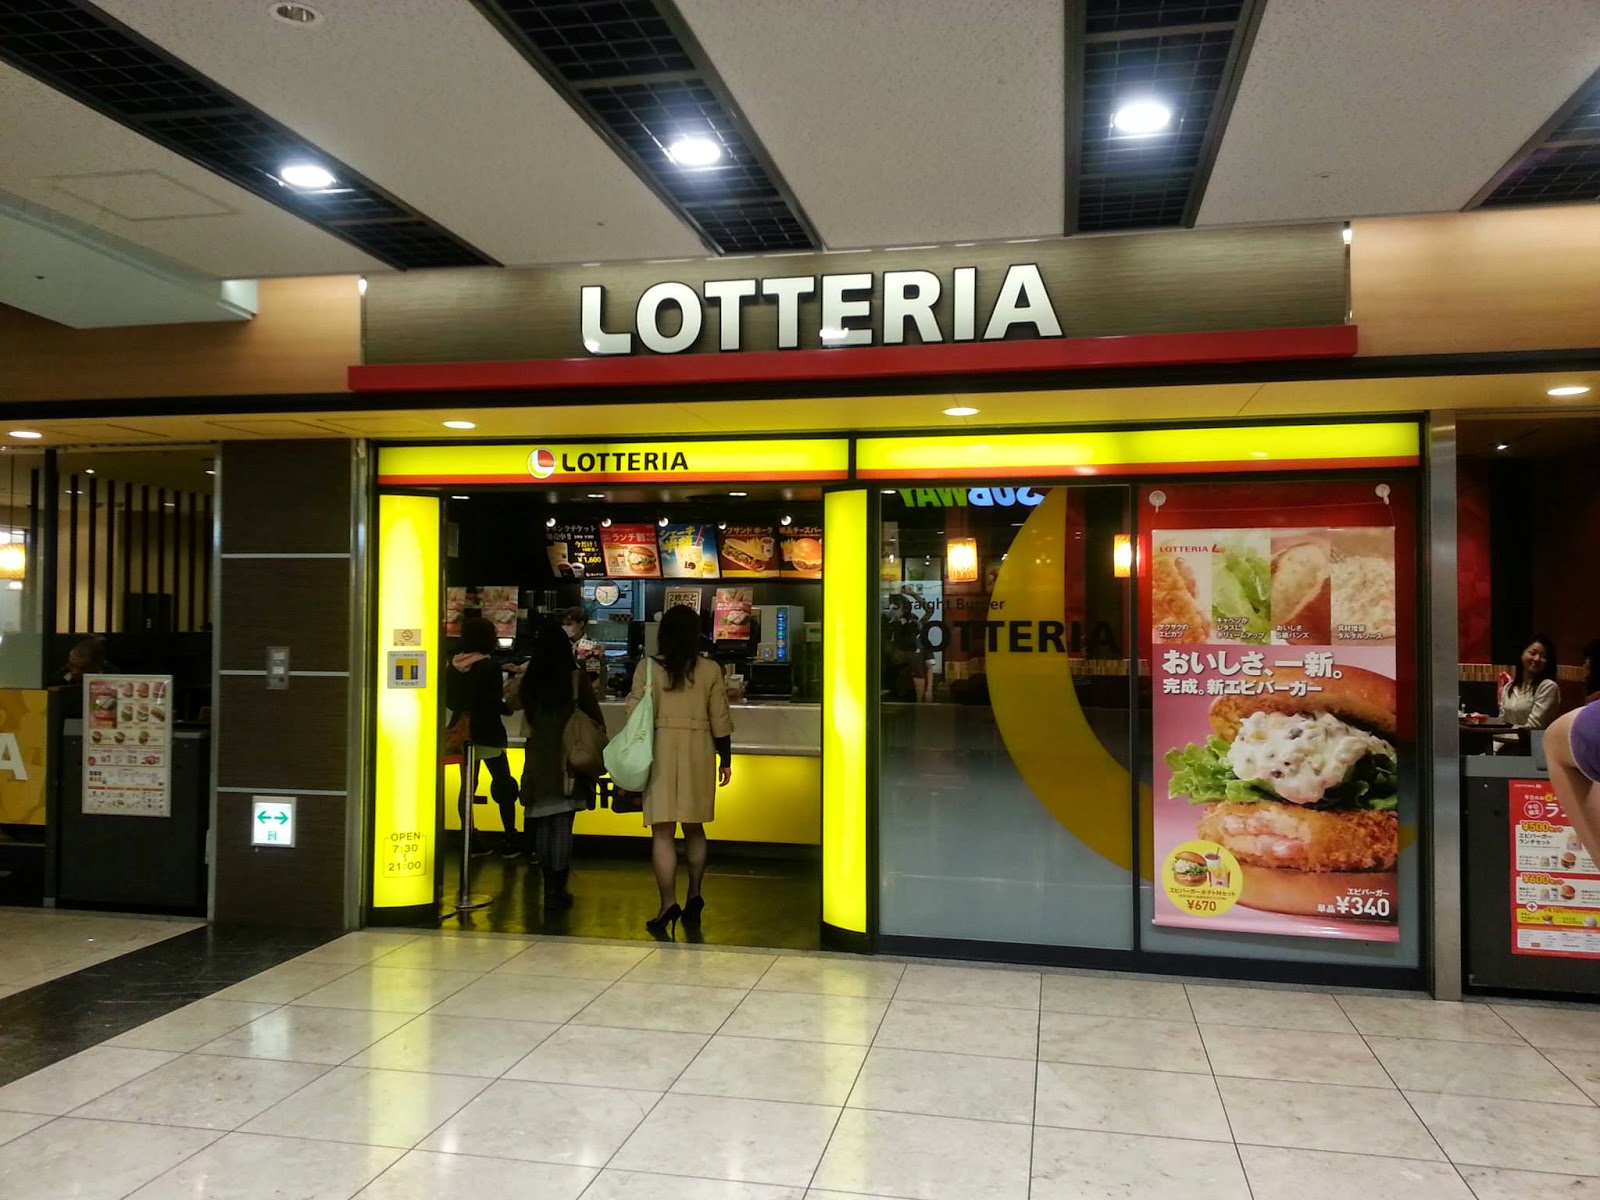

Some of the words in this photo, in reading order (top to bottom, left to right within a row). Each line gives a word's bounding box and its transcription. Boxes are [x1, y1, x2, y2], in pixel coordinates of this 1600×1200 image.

[580, 263, 1063, 355] LOTTERIA
[562, 452, 689, 473] LOTTERIA
[1159, 545, 1209, 553] LOTTERIA
[1162, 650, 1343, 679] おいしさ、一新。
[1162, 678, 1323, 697] 完成。新エビバーガー
[390, 832, 421, 842] OPEN
[392, 844, 418, 853] 7:30
[388, 861, 422, 872] 21:00
[1346, 888, 1390, 896] エビバーガー
[1187, 899, 1217, 912] ¥670
[1336, 895, 1390, 917] ¥340
